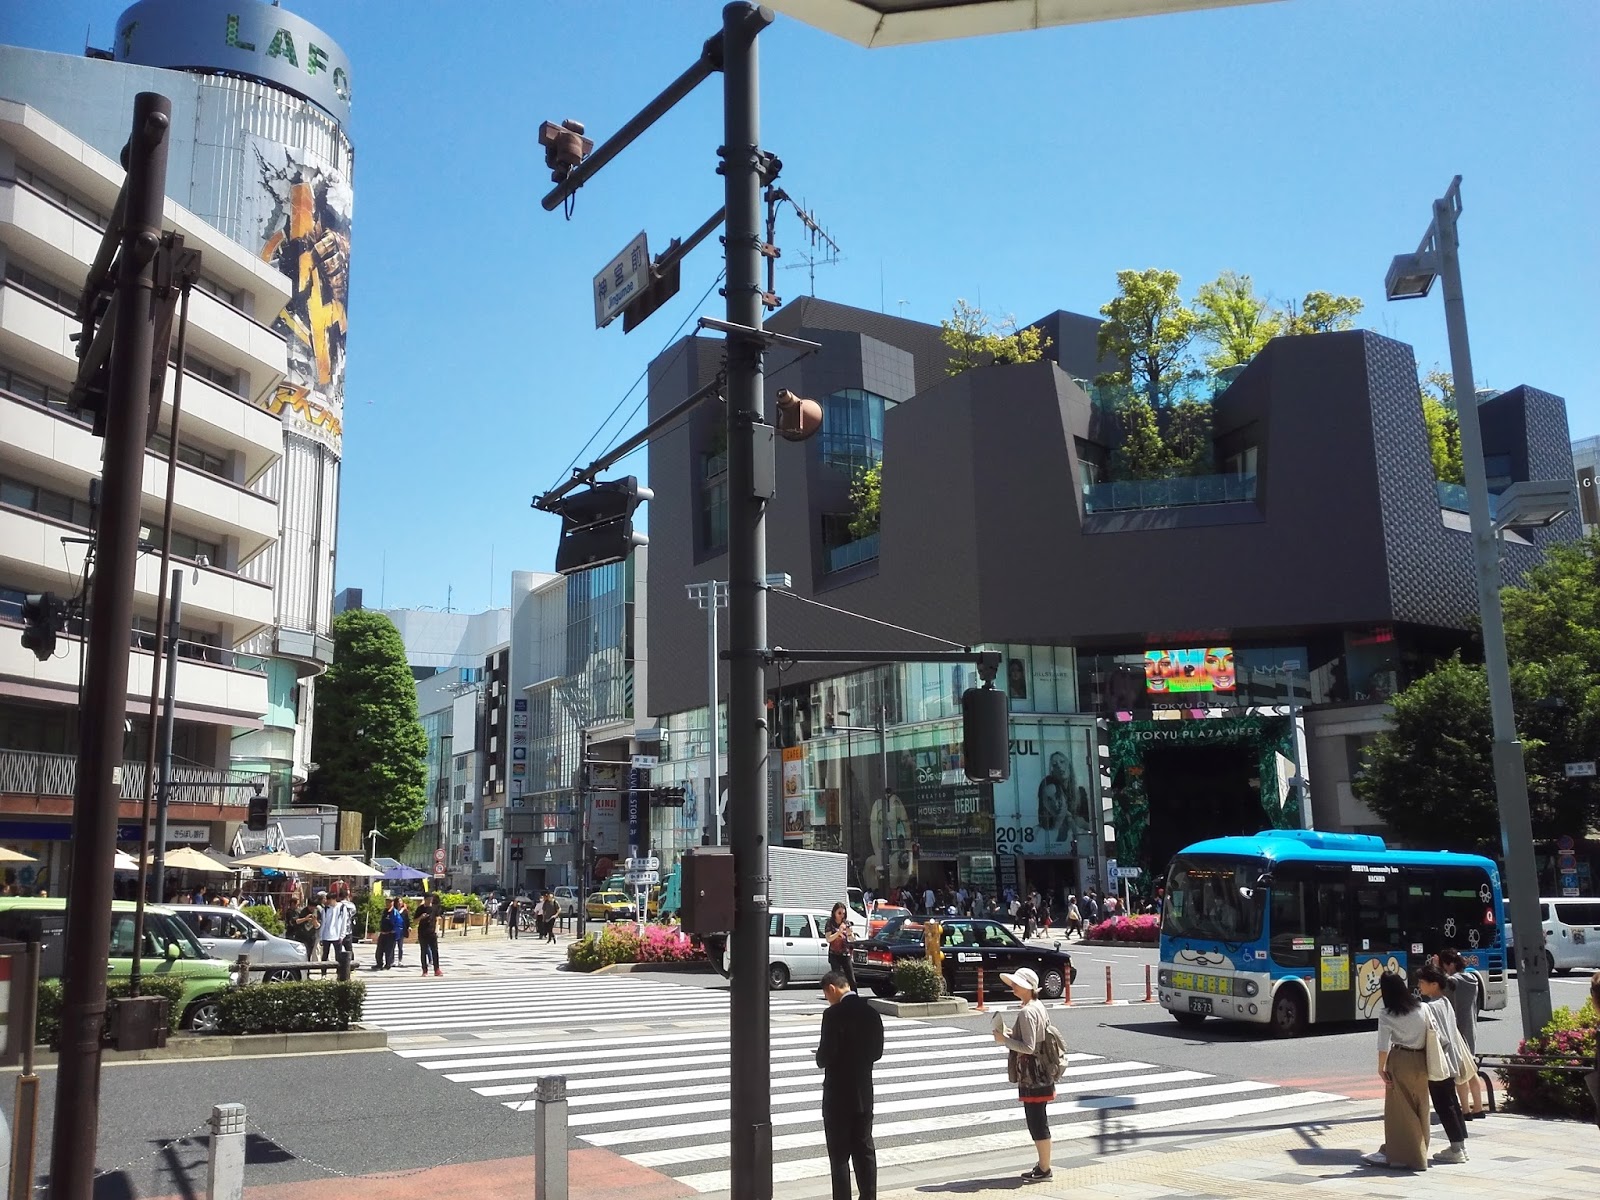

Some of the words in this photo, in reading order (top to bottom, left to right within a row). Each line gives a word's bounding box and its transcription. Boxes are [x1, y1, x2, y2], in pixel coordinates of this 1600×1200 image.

[597, 245, 642, 302] 神宮前
[607, 280, 634, 310] Jingumae
[1197, 701, 1238, 709] PLAZA
[1135, 731, 1178, 741] TOKYU
[1182, 729, 1223, 738] PLAZA
[1227, 727, 1262, 736] WEEK
[954, 797, 980, 814] DEBUT
[996, 827, 1035, 843] 2018
